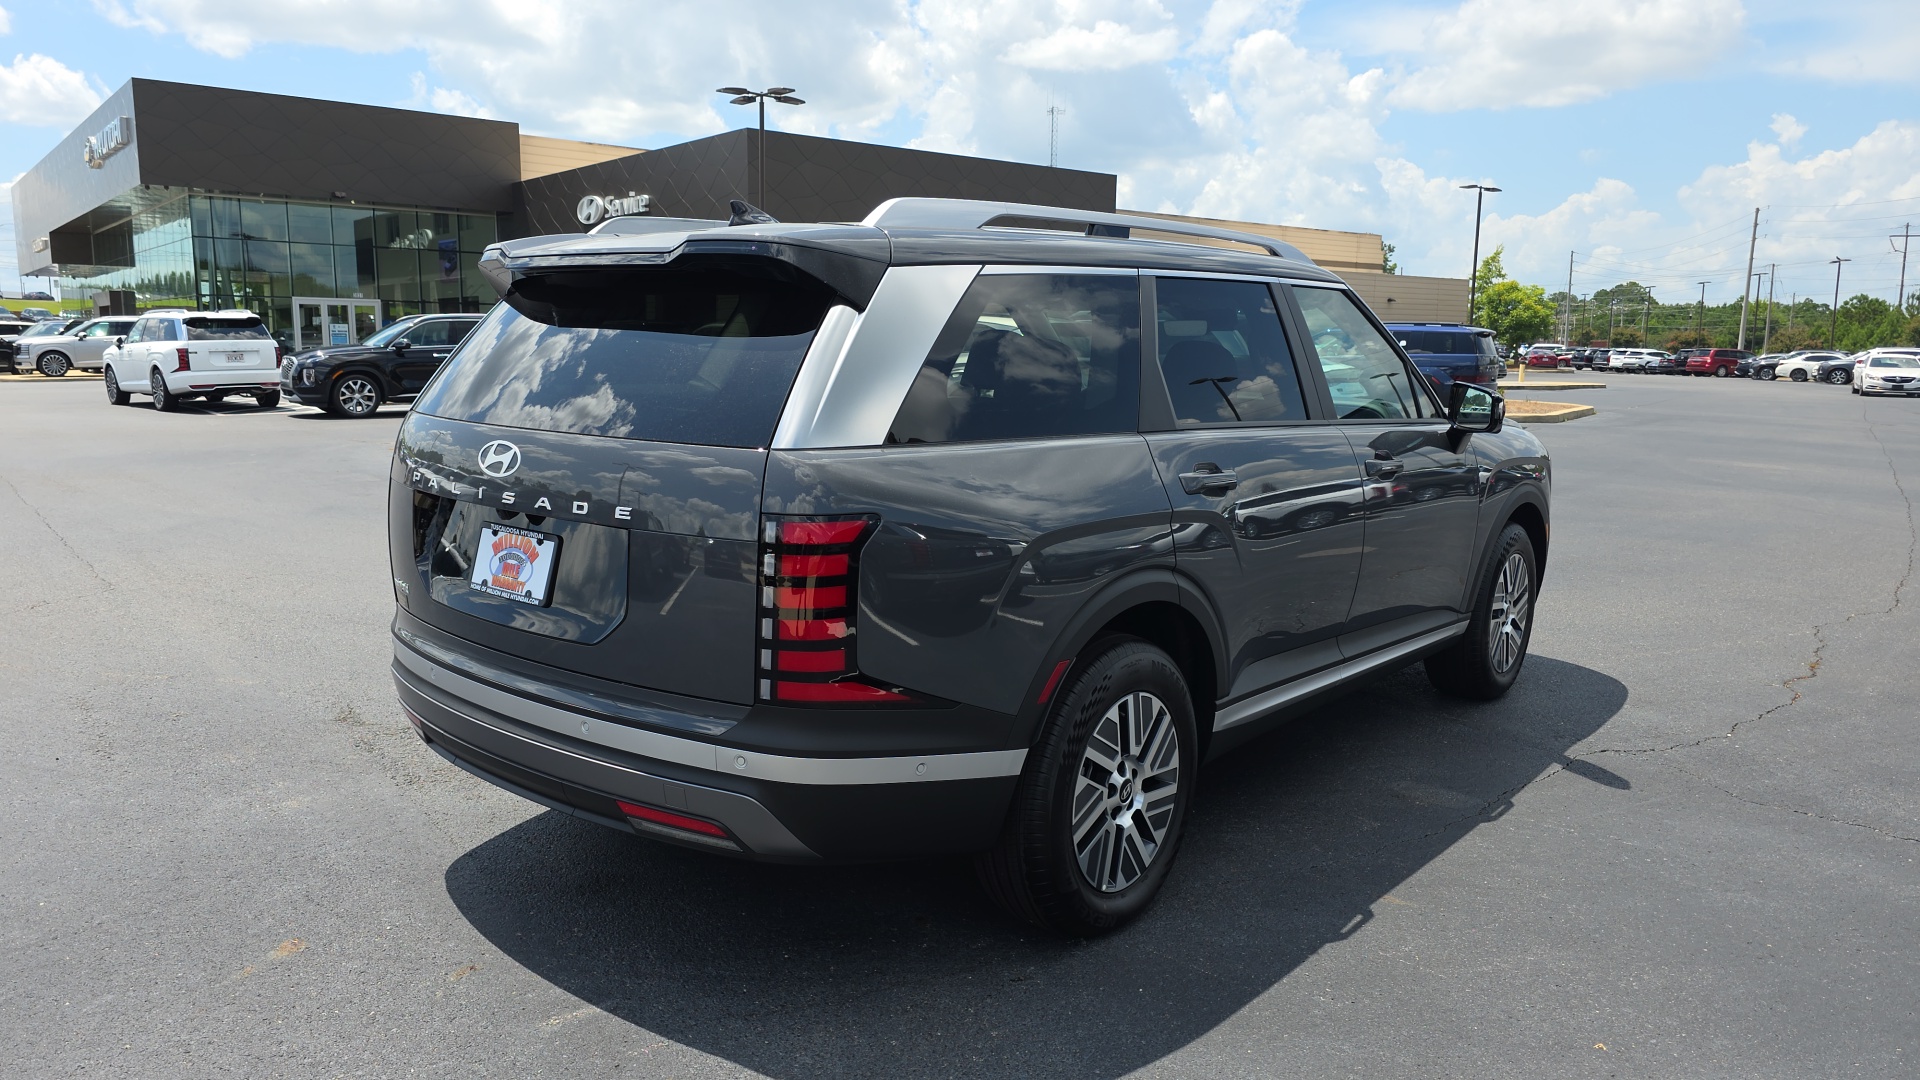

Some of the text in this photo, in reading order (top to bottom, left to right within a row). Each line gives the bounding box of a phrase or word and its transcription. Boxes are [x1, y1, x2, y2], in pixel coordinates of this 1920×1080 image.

[604, 191, 650, 218] Service
[412, 471, 633, 520] PALISADE
[490, 524, 544, 540] TUSCALOOSA HYUNDAI
[491, 533, 540, 564] MILLION
[501, 561, 521, 579] MILE
[470, 583, 481, 591] HOME
[486, 588, 501, 597] MILLION
[500, 591, 510, 599] MILE
[491, 574, 526, 594] WARRANTY
